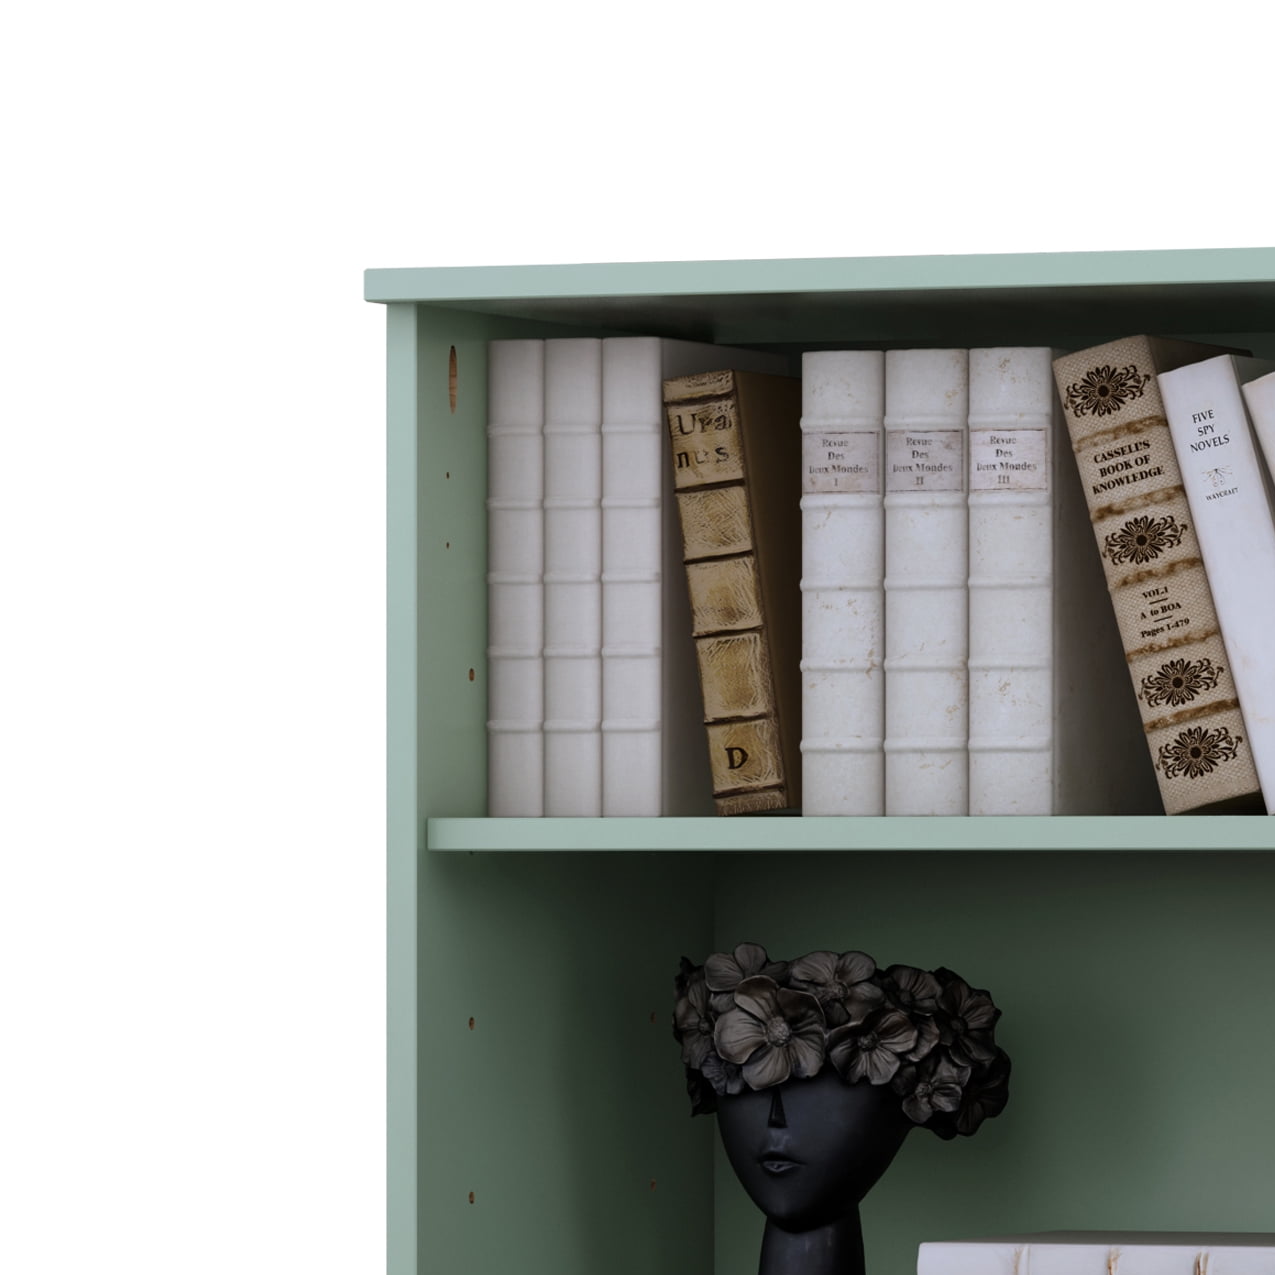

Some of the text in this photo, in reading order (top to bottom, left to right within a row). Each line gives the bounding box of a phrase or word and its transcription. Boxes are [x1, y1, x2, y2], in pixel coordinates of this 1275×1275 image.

[1192, 409, 1215, 424] FIVE
[1197, 424, 1215, 437] SPY
[1190, 434, 1230, 453] NOVELS
[827, 451, 845, 460] Des
[911, 450, 929, 459] Des
[995, 448, 1013, 458] Des
[1093, 439, 1151, 464] CASSELL'S
[831, 464, 869, 474] Mondes
[914, 462, 953, 473] Mondes
[998, 460, 1037, 471] Mondes
[1099, 454, 1151, 478] BOOK OF
[1092, 465, 1165, 495] KNOWLEDGE
[1160, 602, 1182, 613] BOA
[725, 746, 749, 770] D
